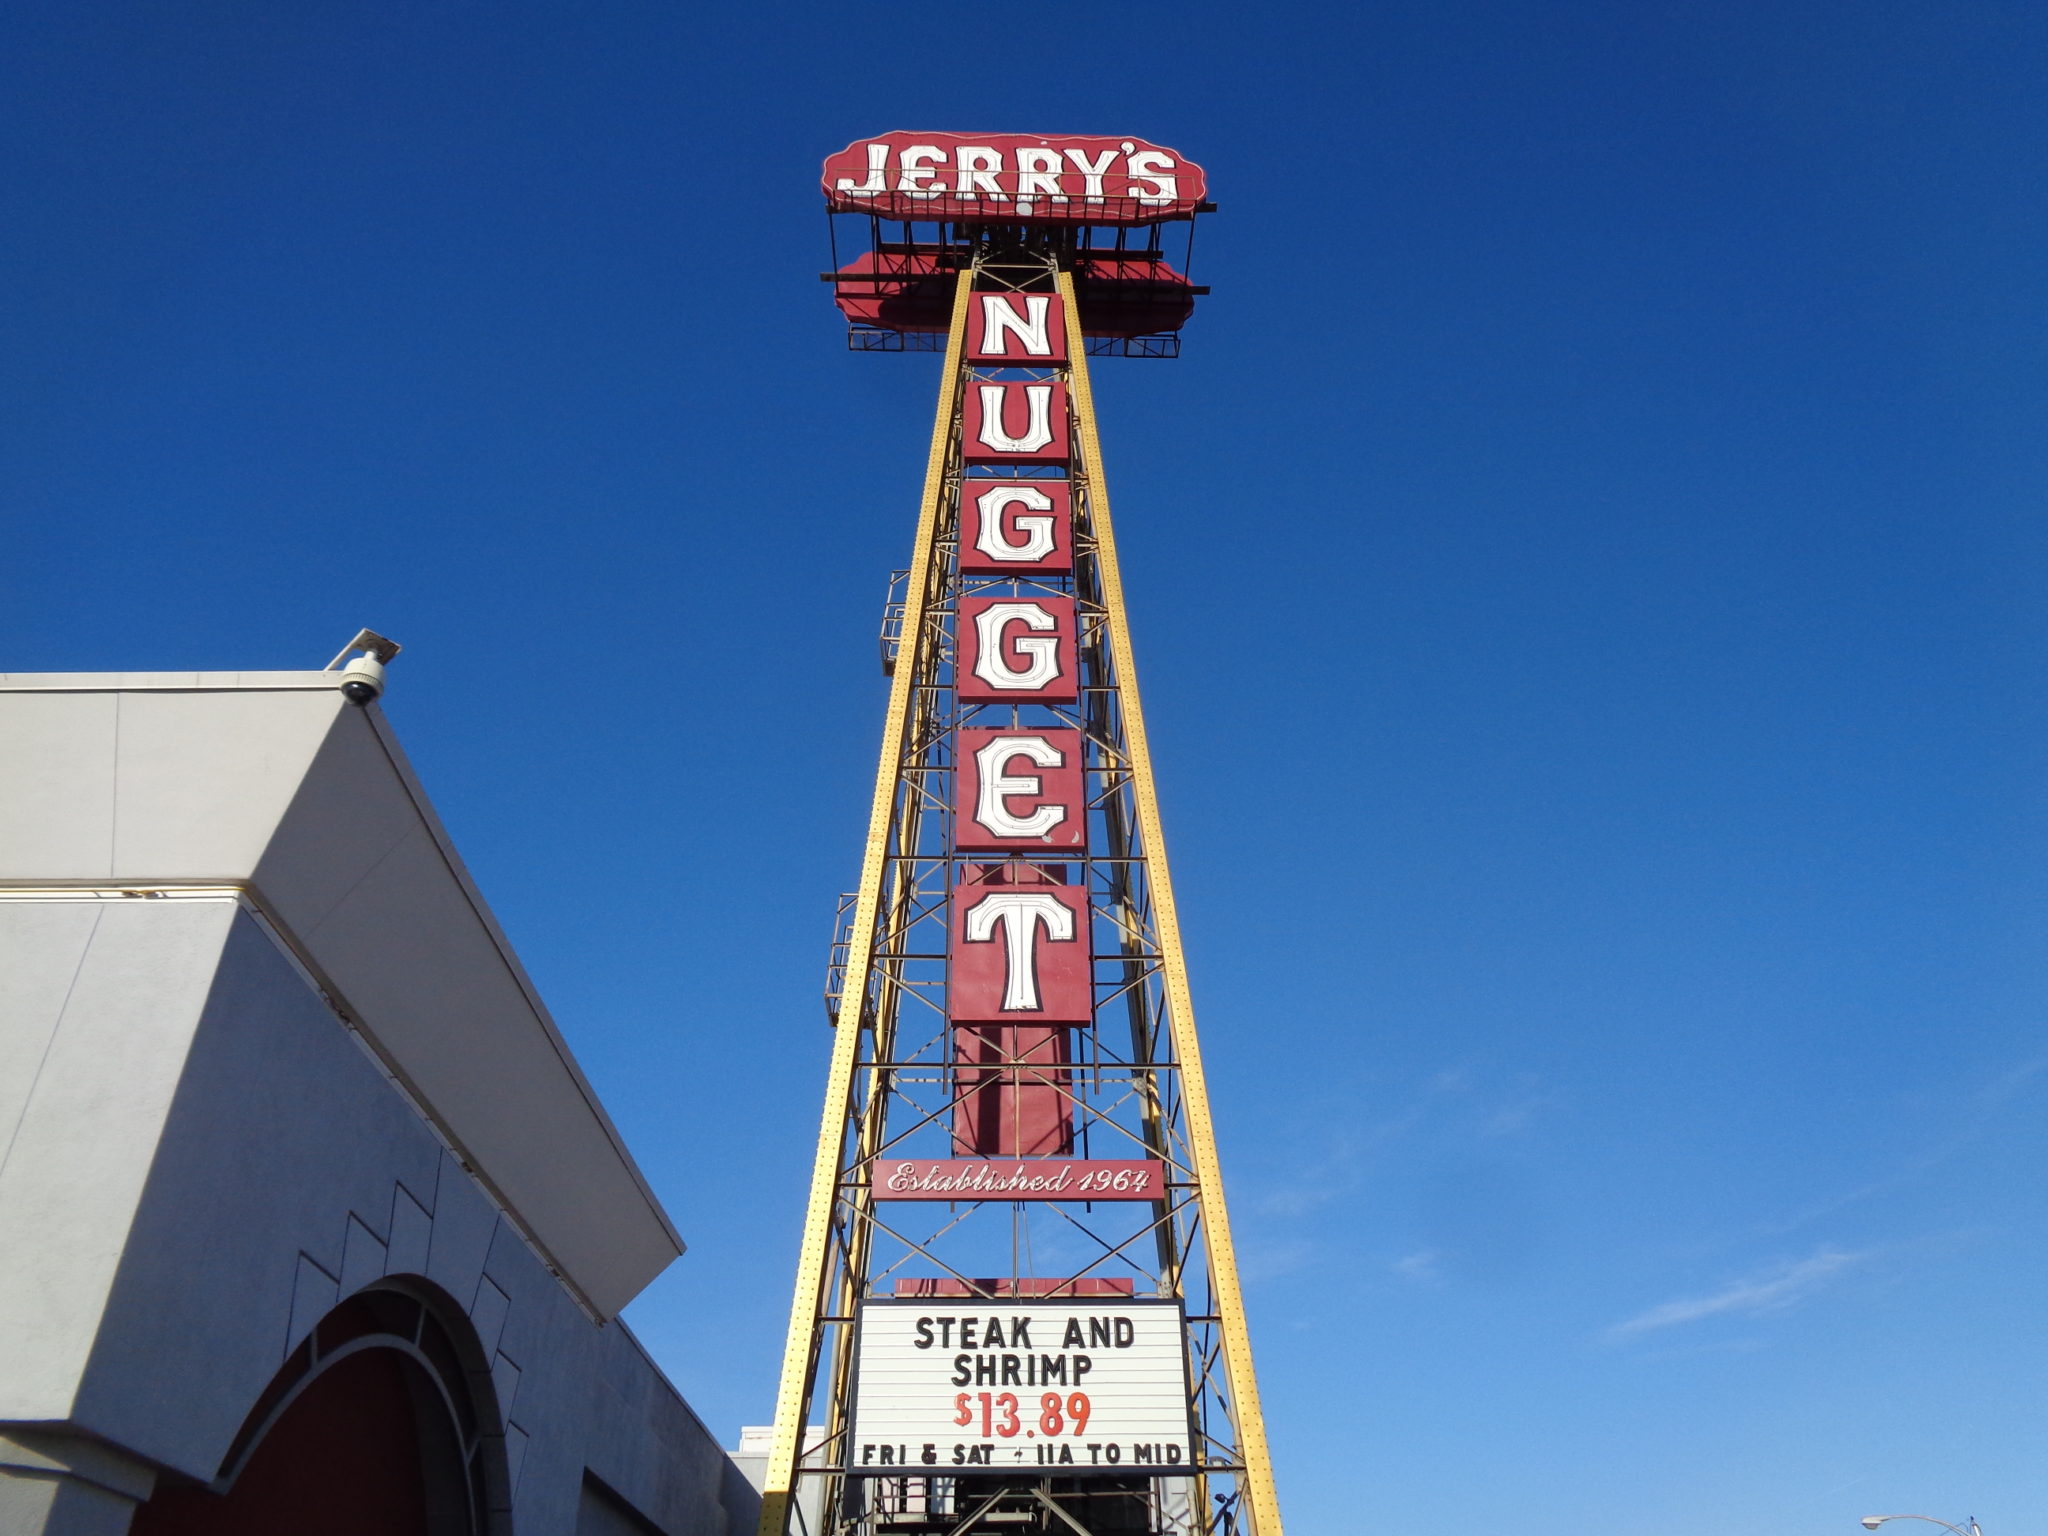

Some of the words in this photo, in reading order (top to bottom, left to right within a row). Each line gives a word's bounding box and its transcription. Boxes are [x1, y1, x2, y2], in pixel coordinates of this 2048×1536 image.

[837, 141, 1178, 207] JERRY'S
[966, 295, 1076, 1012] NUGGET
[887, 1162, 1072, 1192] Established
[1077, 1169, 1151, 1193] 1964
[914, 1316, 1032, 1349] STEAK
[1062, 1316, 1134, 1348] AND
[951, 1353, 1092, 1386] SHRIMP
[953, 1391, 1091, 1438] $13.89
[862, 1444, 906, 1465] FRI
[921, 1443, 937, 1465] &
[951, 1444, 995, 1465] SAT
[1087, 1443, 1121, 1464] TO
[1134, 1443, 1182, 1465] MID
